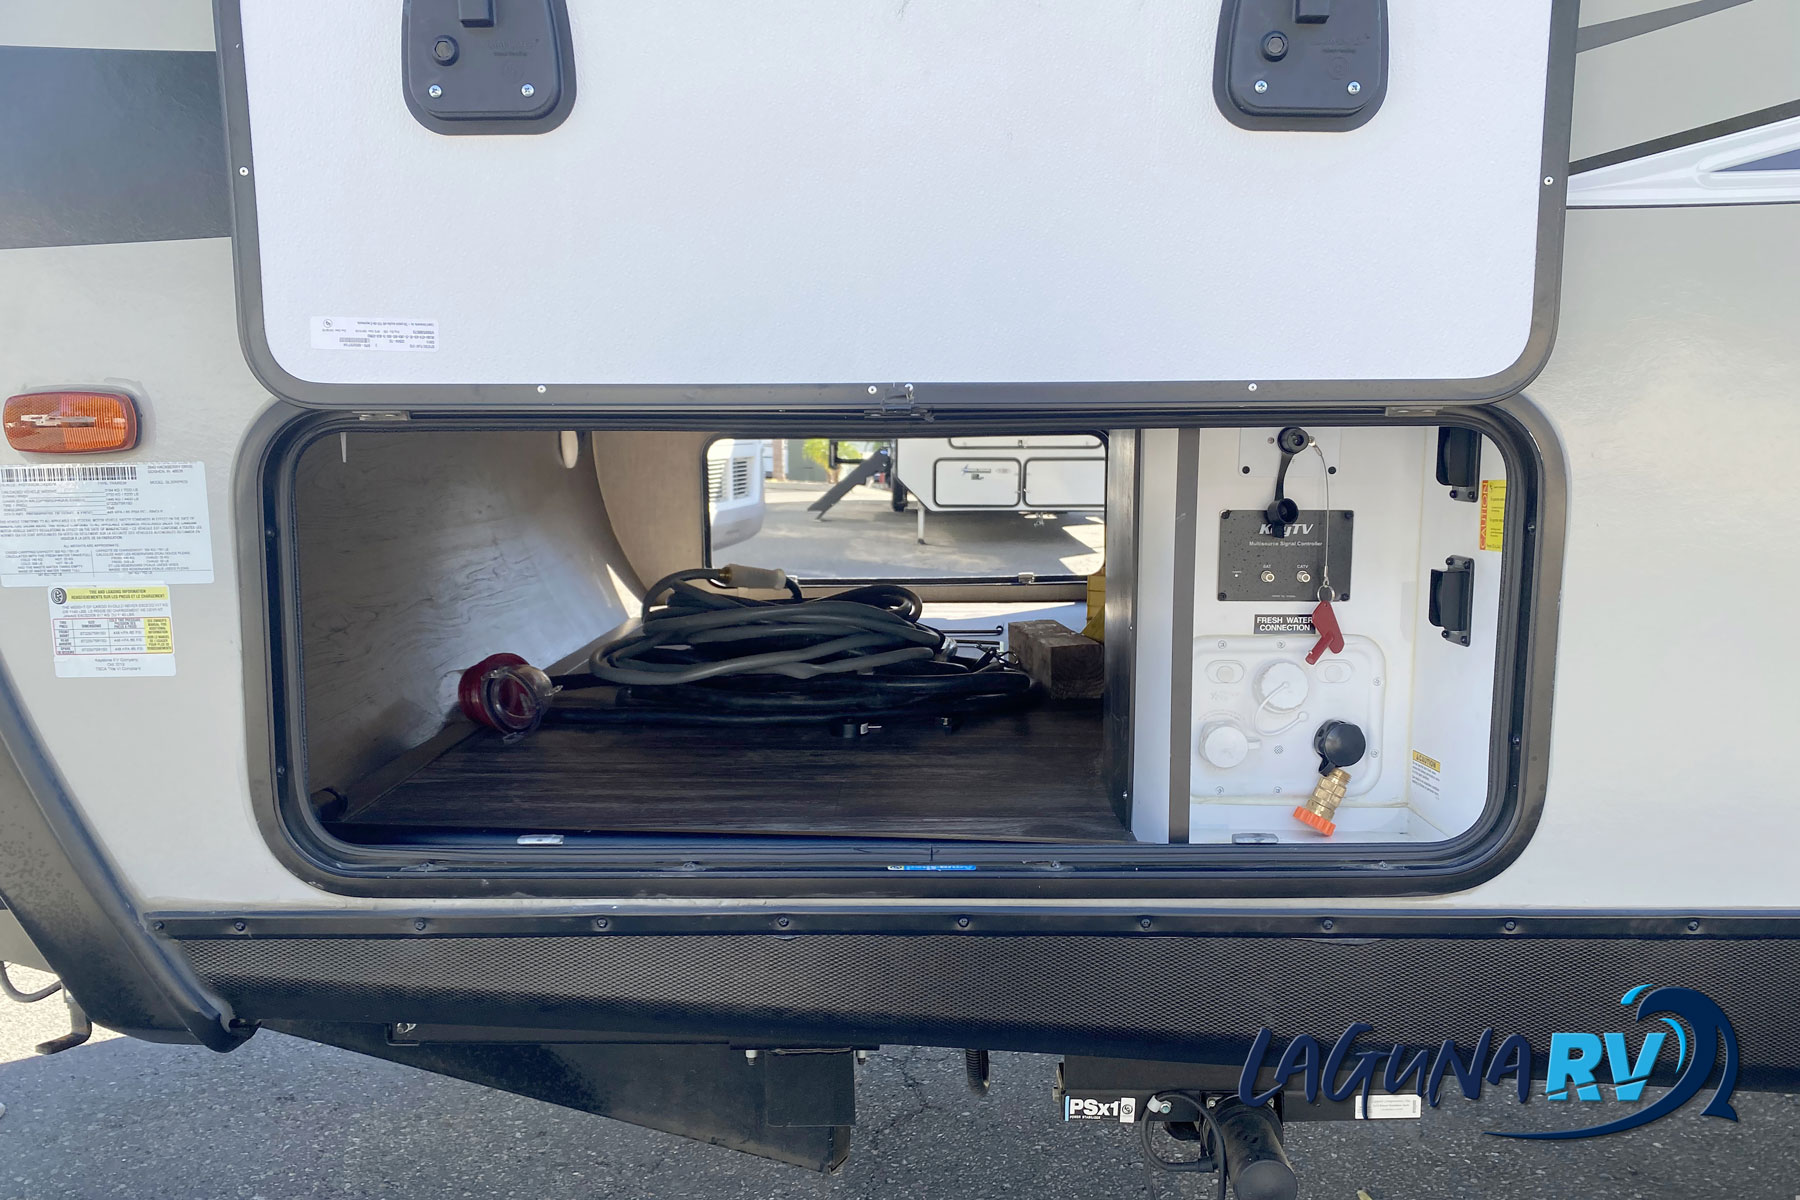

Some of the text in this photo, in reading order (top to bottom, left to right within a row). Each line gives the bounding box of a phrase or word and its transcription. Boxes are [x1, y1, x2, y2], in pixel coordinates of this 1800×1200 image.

[1259, 523, 1314, 537] KyTV
[1256, 616, 1313, 624] FRESH WATER
[1070, 1098, 1119, 1116] PSx1
